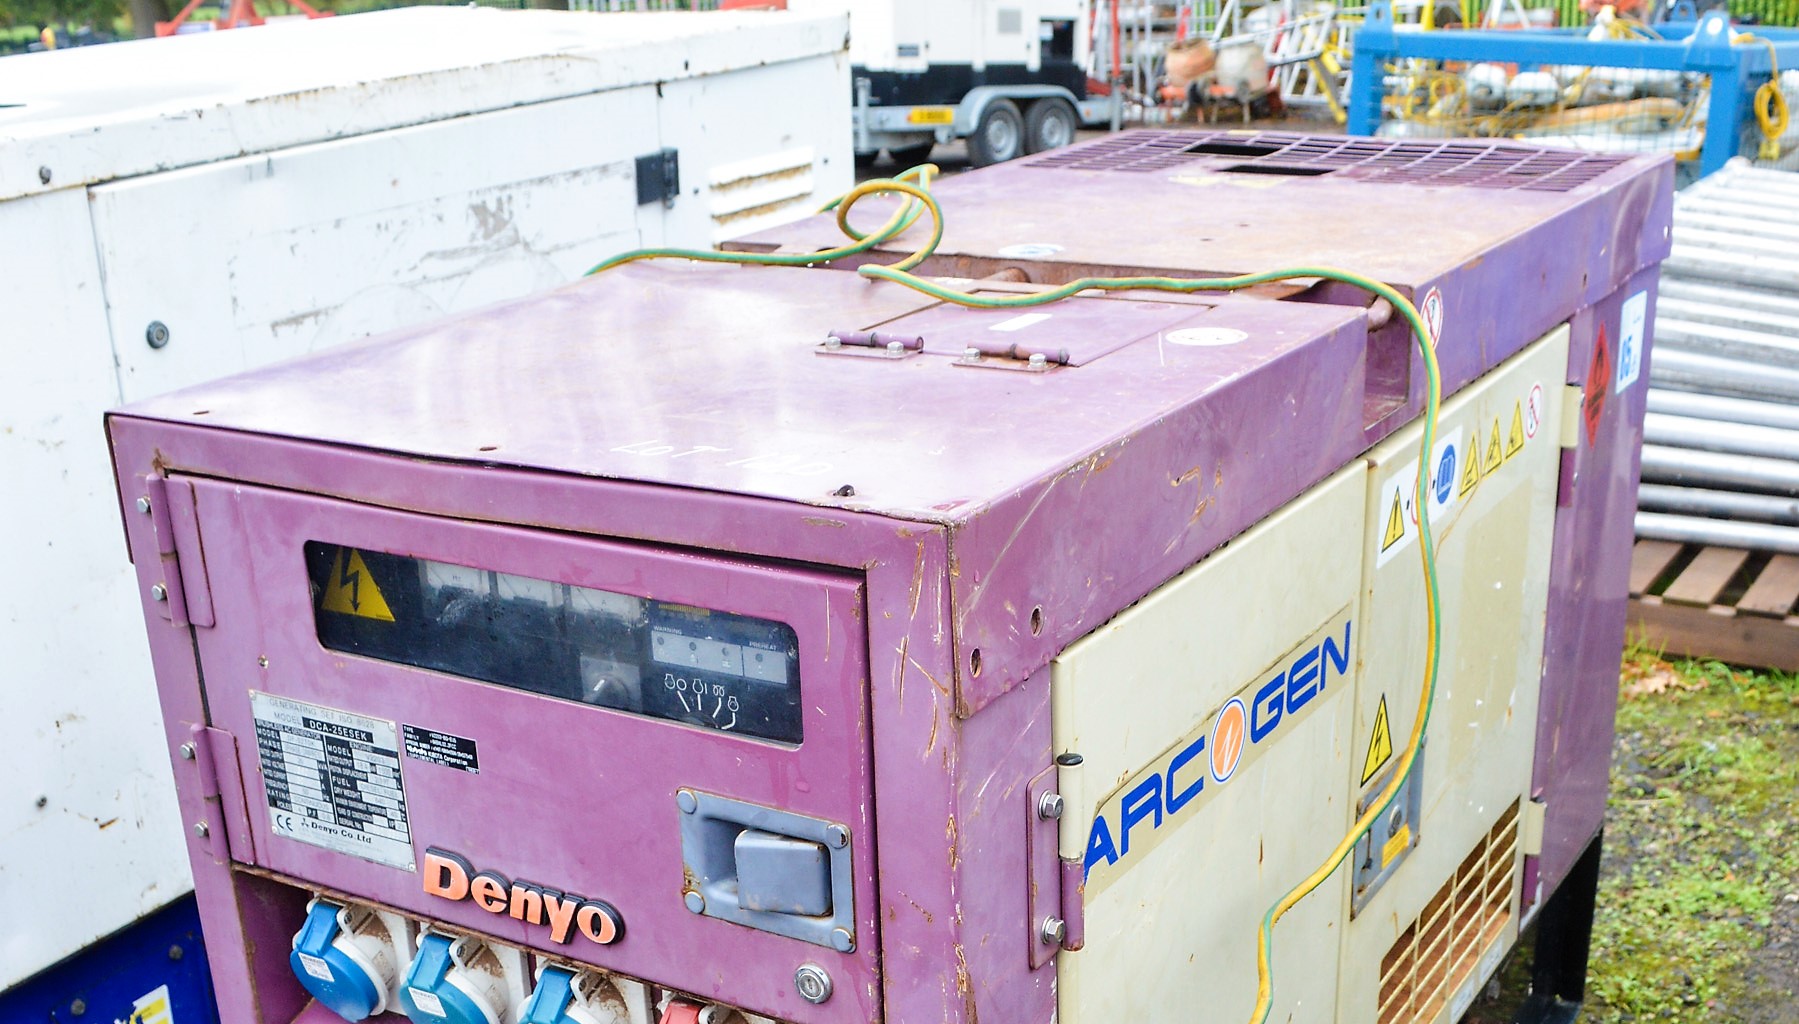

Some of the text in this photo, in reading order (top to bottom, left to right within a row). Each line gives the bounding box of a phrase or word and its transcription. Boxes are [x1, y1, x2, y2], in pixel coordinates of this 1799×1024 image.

[609, 439, 733, 459] LOT
[652, 624, 683, 636] WARNING
[269, 698, 317, 716] GENERATING
[257, 727, 280, 739] MODEL
[273, 711, 302, 727] MODEL
[309, 719, 368, 741] DCA-25ESEK
[327, 744, 352, 757] MODEL
[332, 775, 351, 787] FUEL
[311, 821, 338, 835] Denyo
[423, 846, 625, 945] Denyo
